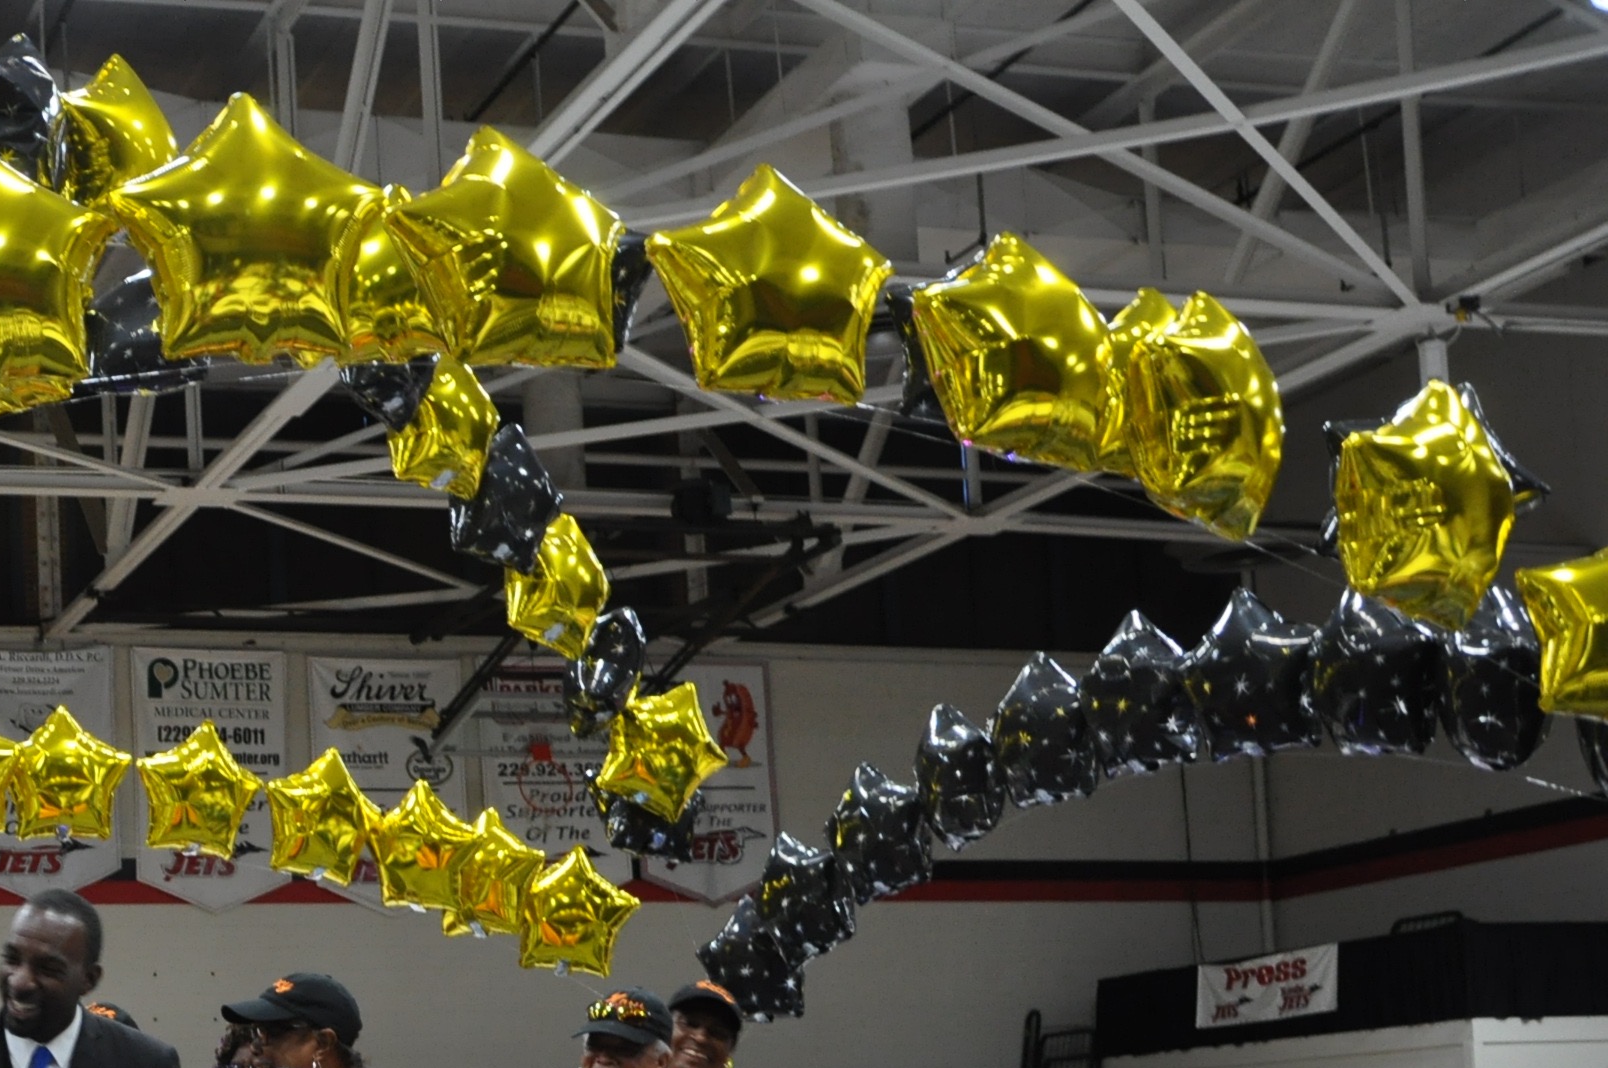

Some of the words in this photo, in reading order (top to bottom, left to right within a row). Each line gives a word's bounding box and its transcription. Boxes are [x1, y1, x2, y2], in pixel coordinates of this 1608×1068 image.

[182, 658, 273, 682] PHOEBE
[180, 680, 273, 702] SUMTER
[330, 665, 432, 703] Shiver
[154, 706, 215, 719] MEDICAL
[218, 708, 270, 720] CENTER
[529, 788, 587, 803] Proud
[525, 827, 550, 844] Of
[558, 826, 590, 841] The
[1223, 957, 1308, 992] Press
